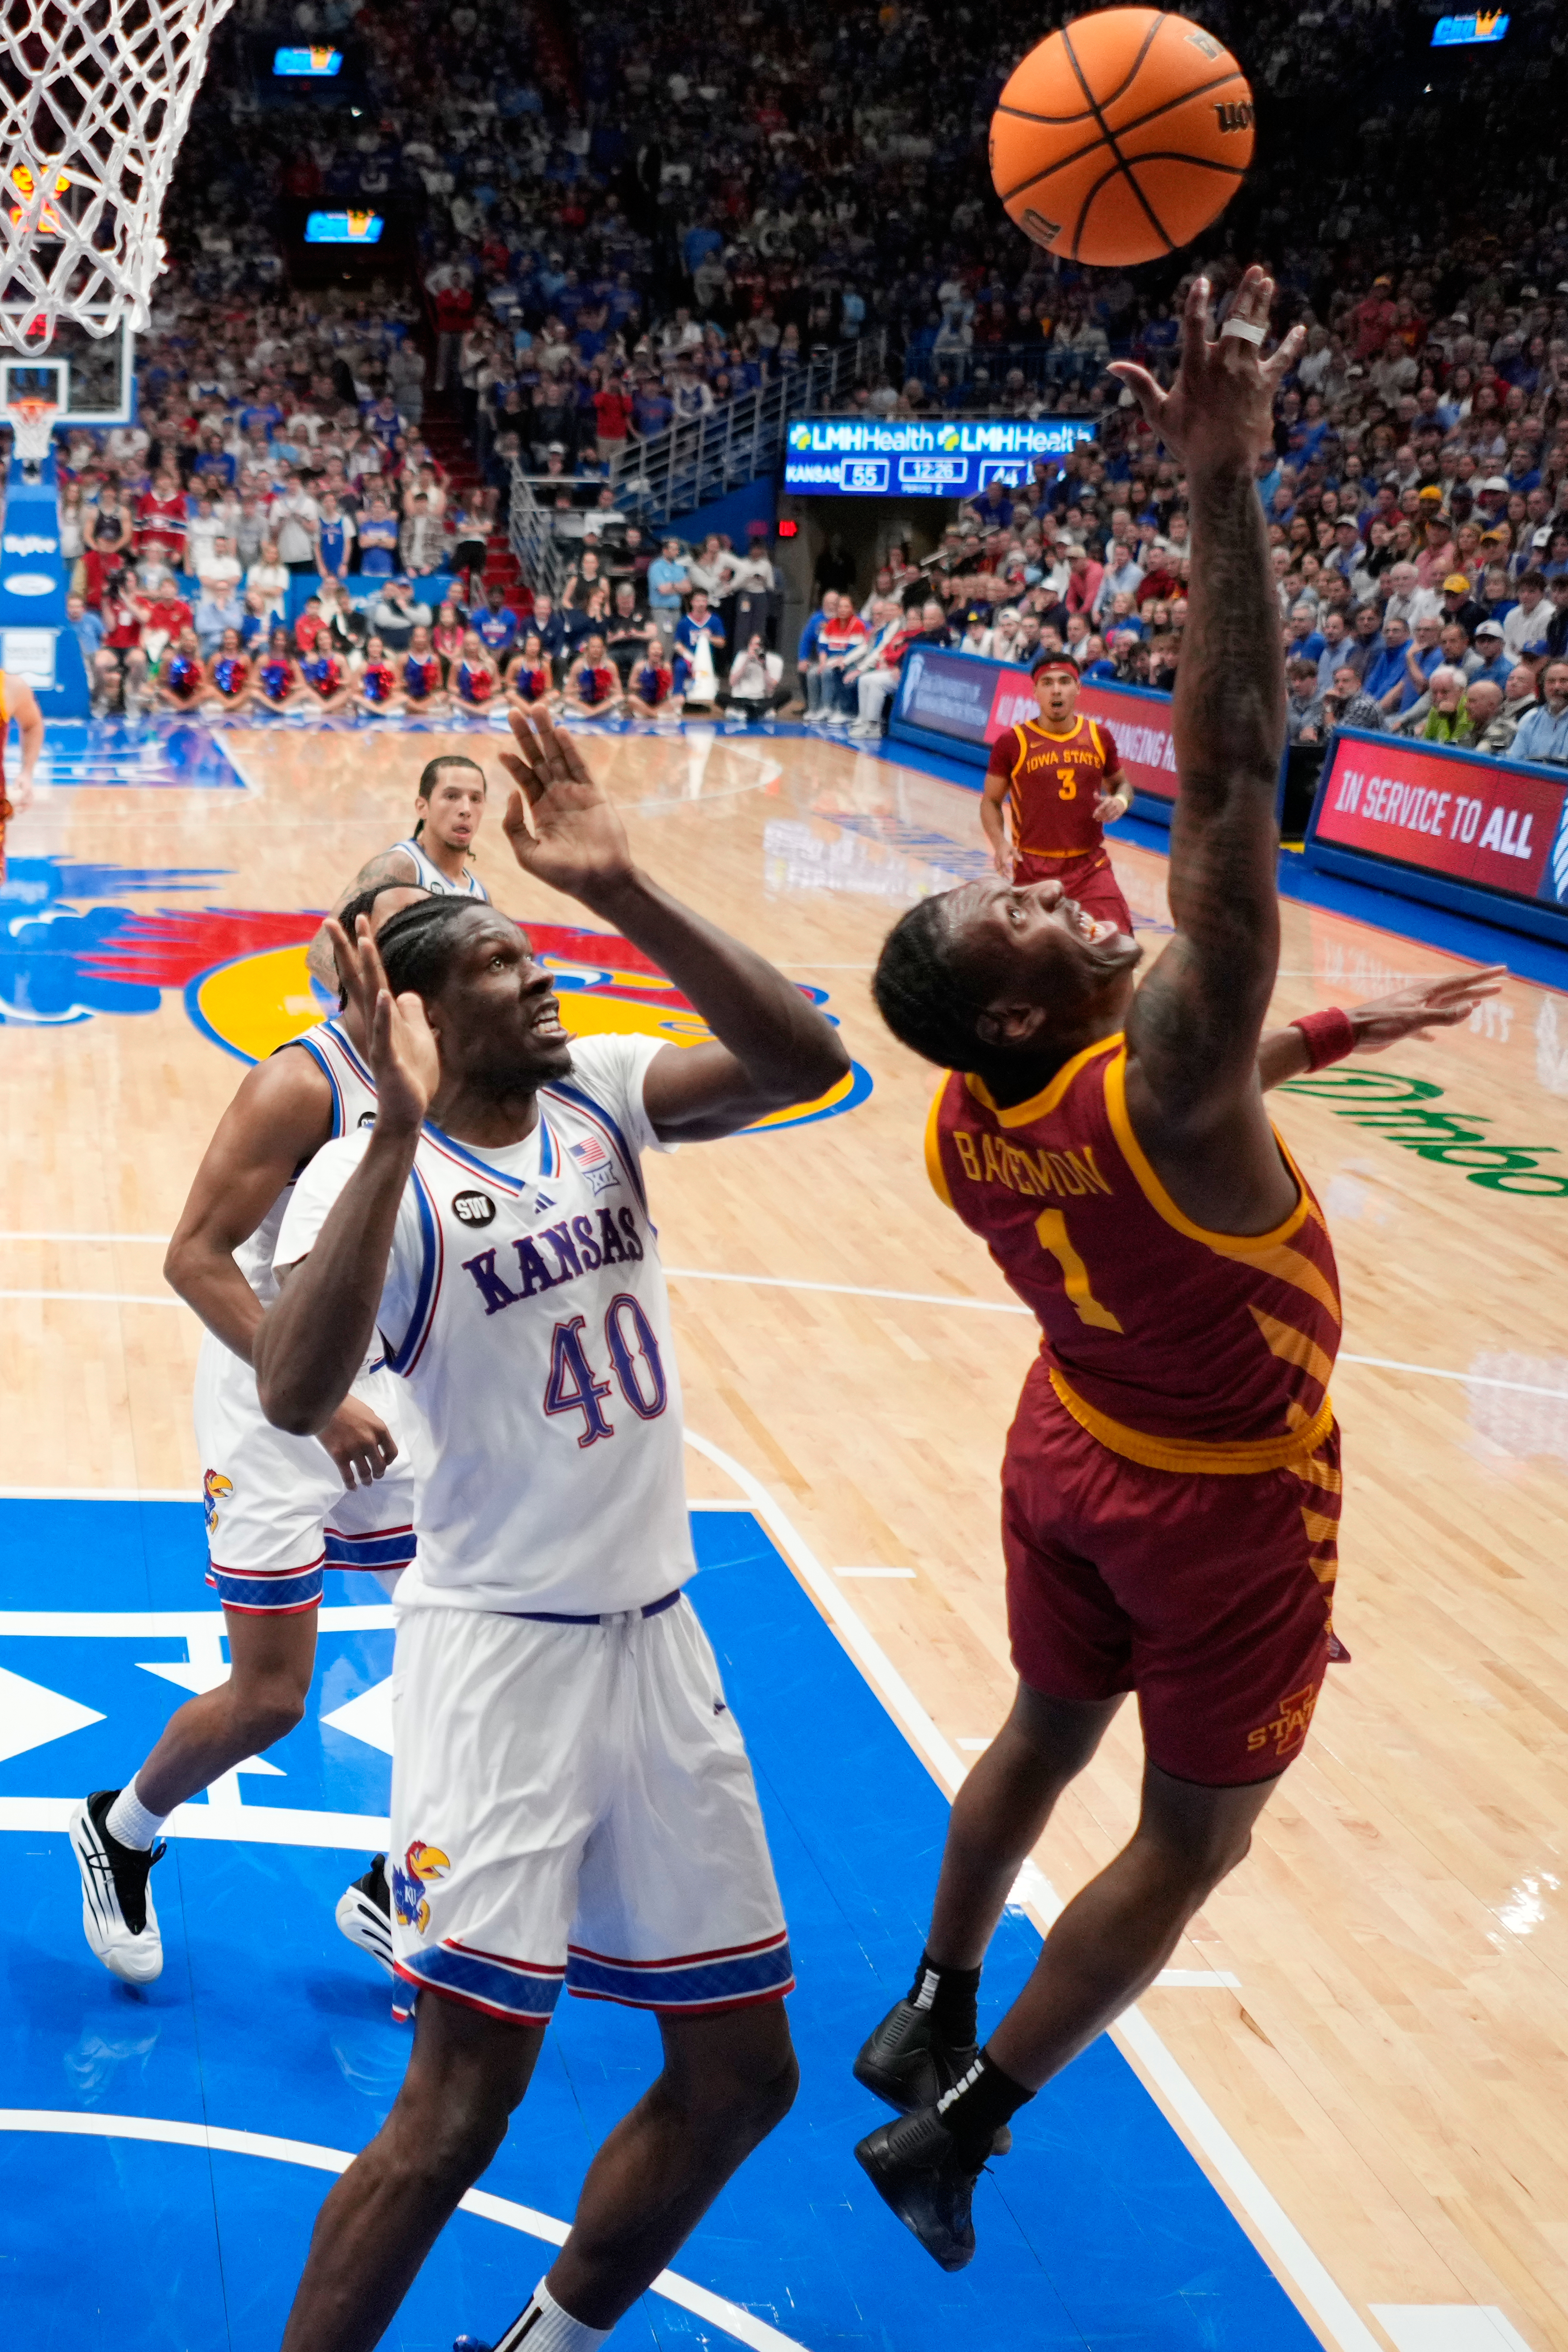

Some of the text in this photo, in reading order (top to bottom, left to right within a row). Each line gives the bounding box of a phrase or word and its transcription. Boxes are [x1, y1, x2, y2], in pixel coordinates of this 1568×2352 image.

[786, 463, 840, 483] KANSAS
[852, 464, 877, 486] 55
[1026, 749, 1101, 773] IOWA STATE
[1056, 768, 1077, 801] 3
[1334, 770, 1535, 860] IN SERVICE TO ALL
[952, 1131, 1114, 1196] BATEMON
[456, 1195, 490, 1220] SW
[461, 1206, 644, 1316] KANSAS
[1034, 1208, 1124, 1334] 1
[543, 1293, 667, 1448] 40
[404, 1884, 416, 1907] KU
